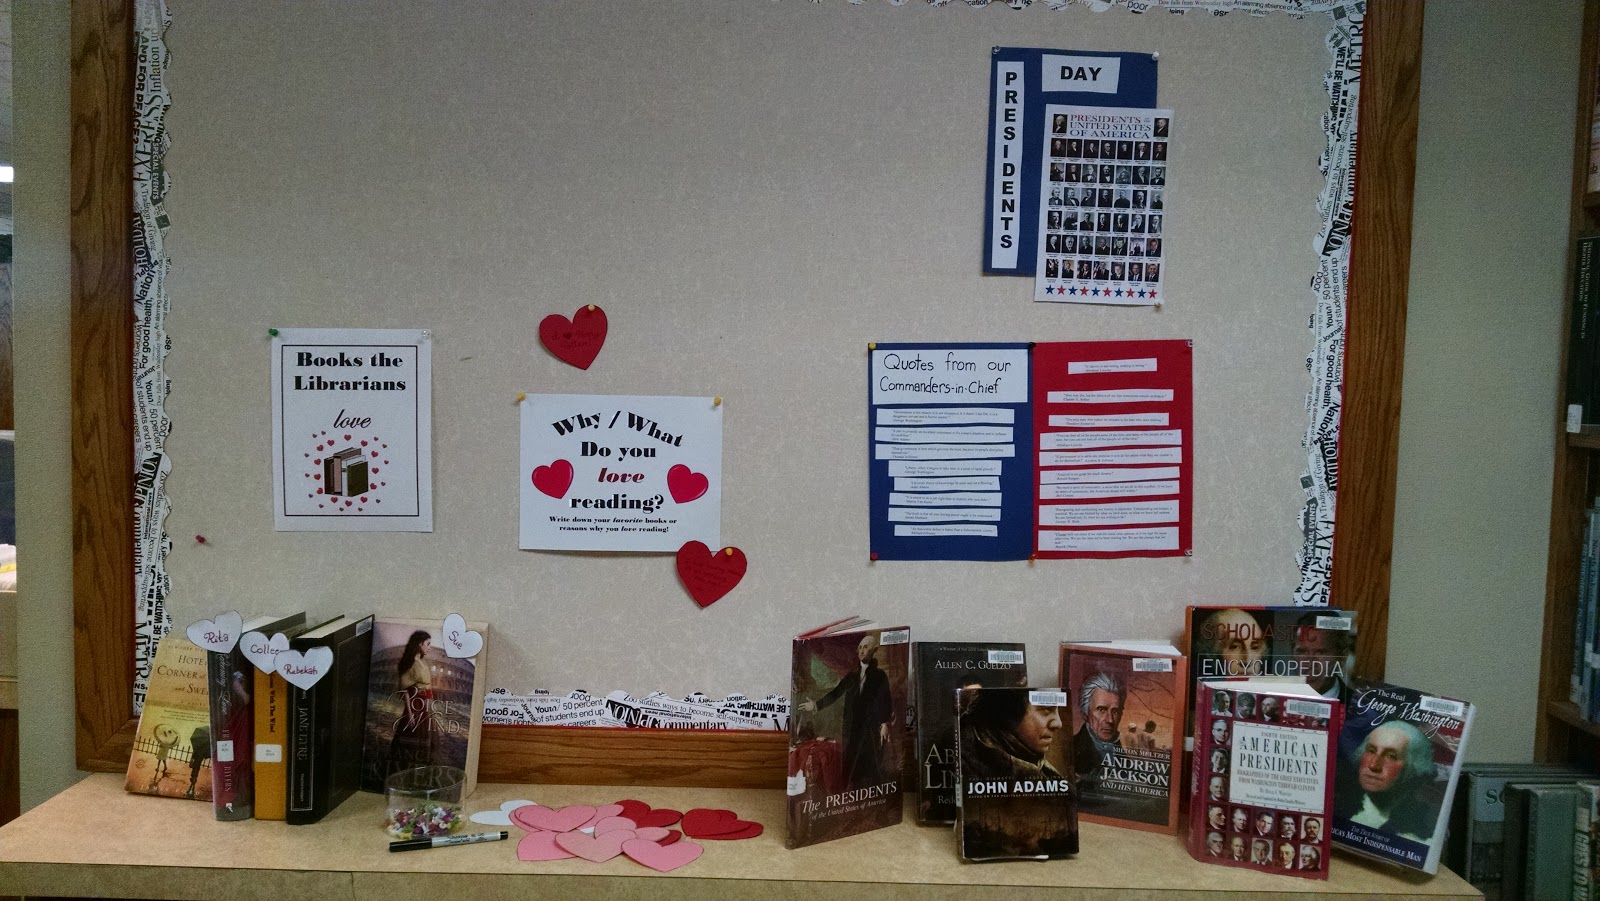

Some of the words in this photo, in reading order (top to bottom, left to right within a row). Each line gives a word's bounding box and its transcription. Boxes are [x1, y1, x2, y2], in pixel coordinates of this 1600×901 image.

[138, 35, 150, 63] AND
[135, 65, 146, 92] FOR
[149, 46, 161, 92] Inflation
[1060, 65, 1102, 82] DAY
[1070, 114, 1141, 124] PRESIDENTS
[1070, 121, 1110, 130] UNITED
[1112, 123, 1152, 132] STATES
[1070, 129, 1088, 137] OF
[1091, 130, 1150, 139] AMERICA
[151, 142, 159, 171] SPECIAL
[999, 71, 1018, 249] PRESIDENTS
[133, 215, 148, 270] HOLIDAY
[1320, 260, 1331, 289] percent
[1331, 269, 1339, 284] end
[1323, 290, 1331, 300] 50
[1333, 285, 1342, 320] students
[143, 297, 154, 328] health,
[142, 329, 151, 353] good
[1330, 340, 1338, 352] For
[139, 354, 148, 369] For
[296, 351, 363, 367] Books
[370, 352, 403, 368] the
[883, 353, 934, 371] Quotes
[945, 352, 977, 372] from
[987, 361, 1011, 372] our
[1326, 354, 1334, 378] good
[293, 375, 406, 391] Librarians
[880, 375, 1002, 394] Commanders-in-Chief
[1321, 379, 1333, 409] health,
[137, 390, 148, 424] students
[149, 408, 158, 419] 50
[333, 409, 372, 428] love
[143, 426, 151, 440] end
[151, 420, 163, 450] percent
[551, 412, 601, 437] Why
[627, 411, 683, 447] What
[144, 441, 152, 451] up
[580, 441, 611, 457] Do
[618, 447, 656, 462] you
[1323, 439, 1339, 487] HOLIDAY
[597, 467, 645, 483] love
[569, 494, 664, 514] reading?
[1307, 531, 1315, 557] SPECIAL
[153, 624, 163, 636] BE
[203, 630, 229, 644] Rita
[448, 630, 463, 650] Sue
[1203, 621, 1317, 643] SCHOLASTIC
[178, 654, 207, 666] HOTE
[283, 664, 318, 676] Rebekah
[934, 660, 962, 669] ALLEN
[965, 660, 976, 670] C.
[977, 660, 1011, 670] GUELZO
[1202, 658, 1344, 677] ENCYCLOPEDIA
[157, 665, 198, 679] CORNER
[187, 683, 209, 696] SWE
[1377, 689, 1390, 698] The
[1390, 693, 1406, 702] Real
[387, 686, 454, 714] VOICE
[562, 701, 573, 710] 50
[573, 699, 604, 710] percent
[297, 707, 309, 732] JANE
[392, 711, 460, 734] WIND
[485, 708, 508, 716] good
[509, 710, 524, 719] For
[545, 711, 578, 721] students
[578, 708, 594, 718] end
[594, 708, 605, 717] up
[638, 698, 661, 709] studies
[662, 703, 679, 714] ways
[680, 705, 687, 713] to
[688, 706, 715, 718] become
[715, 713, 763, 727] self-supporting
[1357, 689, 1397, 726] George
[1398, 701, 1461, 739] Washington
[297, 734, 309, 761] EYRE
[1113, 746, 1138, 756] MILTON
[1138, 750, 1170, 760] MELTZER
[1239, 736, 1318, 758] AMERICAN
[1100, 752, 1170, 774] ANDREW
[1239, 752, 1318, 776] PRESIDENTS
[223, 766, 232, 792] RIVERS
[968, 781, 1007, 794] JOHN
[1013, 780, 1069, 793] ADAMS
[1100, 767, 1169, 787] JACKSON
[802, 799, 820, 814] The
[826, 781, 897, 808] PRESIDENTS
[1100, 781, 1117, 789] AND
[1132, 786, 1169, 797] AMERICA
[827, 808, 844, 817] United
[845, 805, 859, 813] States
[866, 799, 886, 807] America
[1346, 831, 1362, 843] MOST
[1363, 837, 1406, 857] INDISPENSABLE
[1406, 851, 1422, 862] MAN
